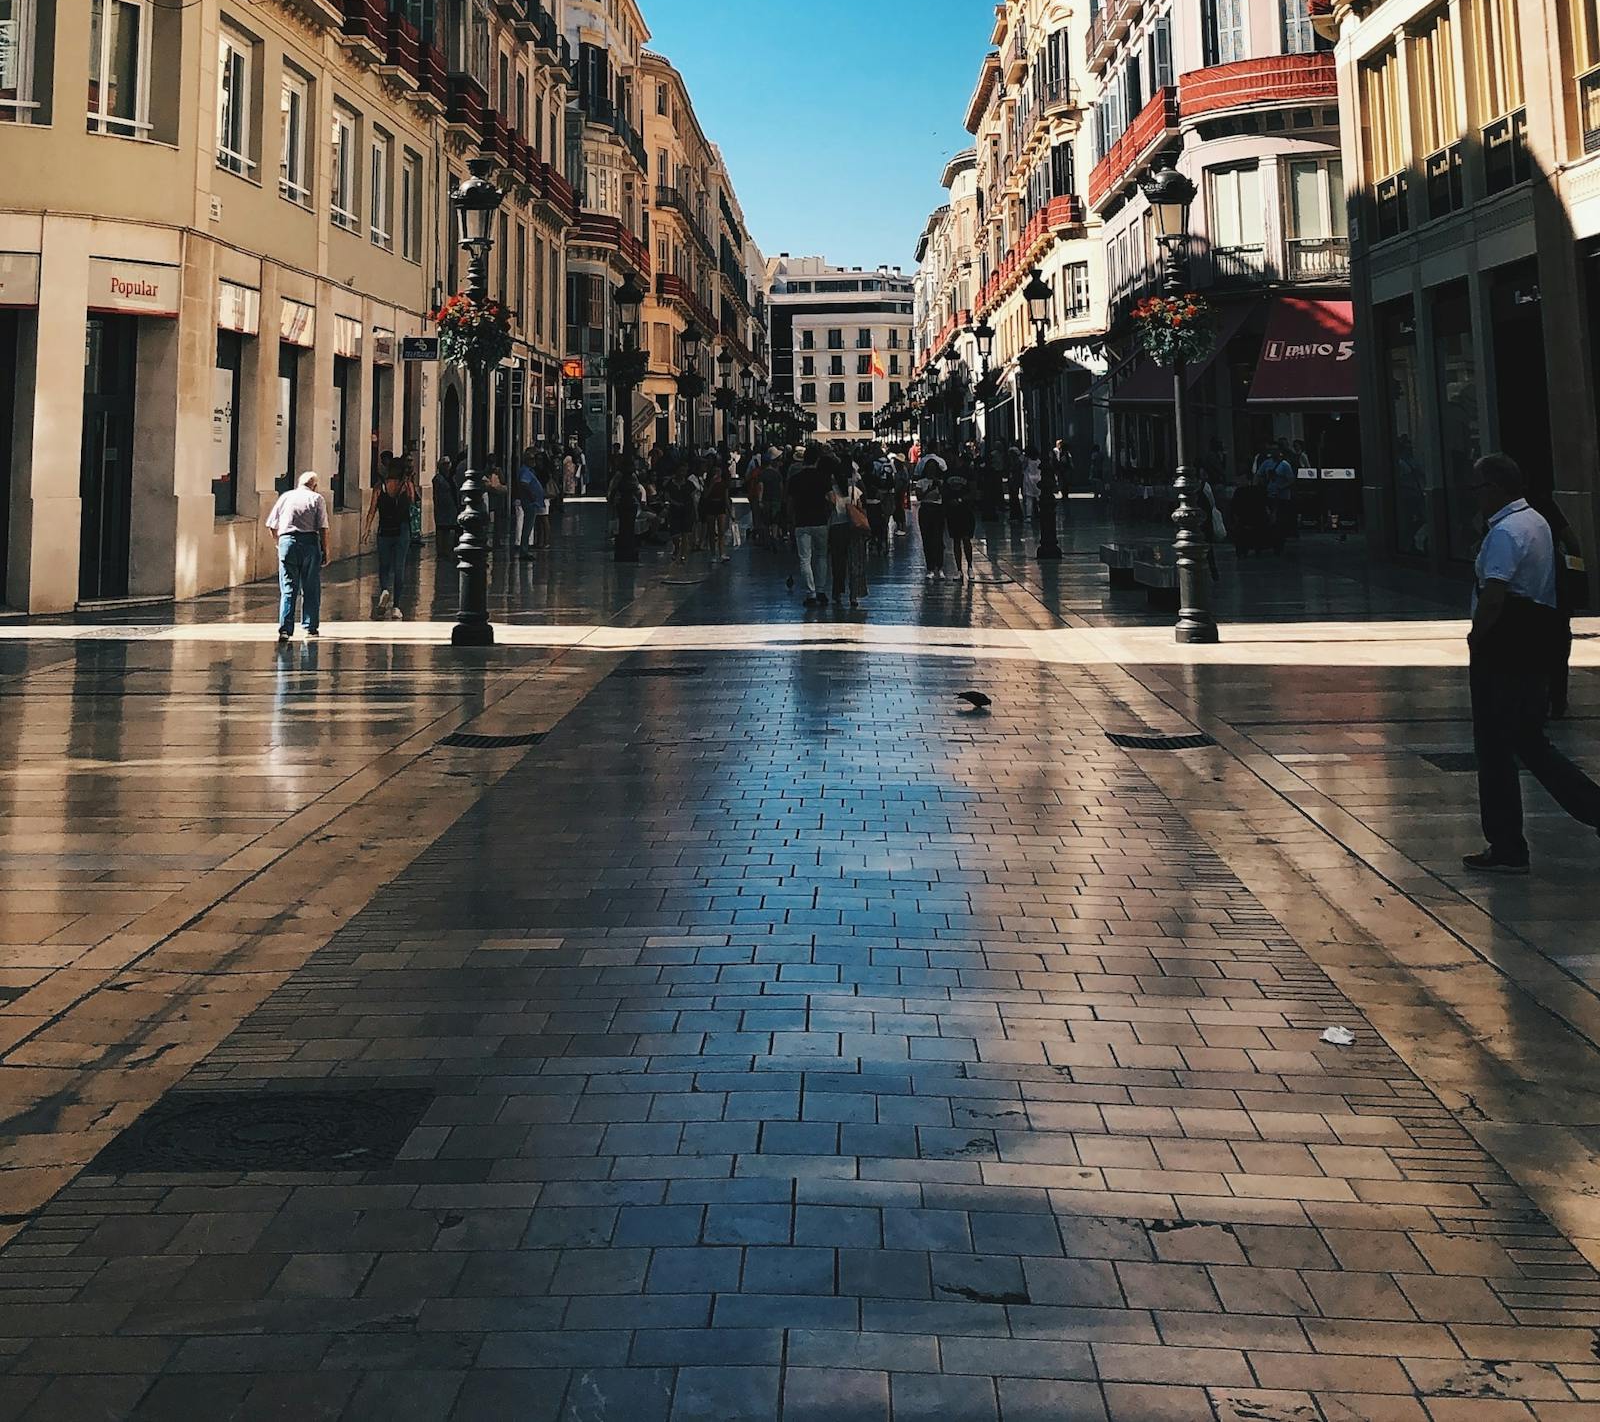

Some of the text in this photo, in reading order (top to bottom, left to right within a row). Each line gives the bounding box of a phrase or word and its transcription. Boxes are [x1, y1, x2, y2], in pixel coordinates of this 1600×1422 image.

[111, 277, 159, 298] Popular
[1264, 340, 1356, 361] LEPANTO 5
